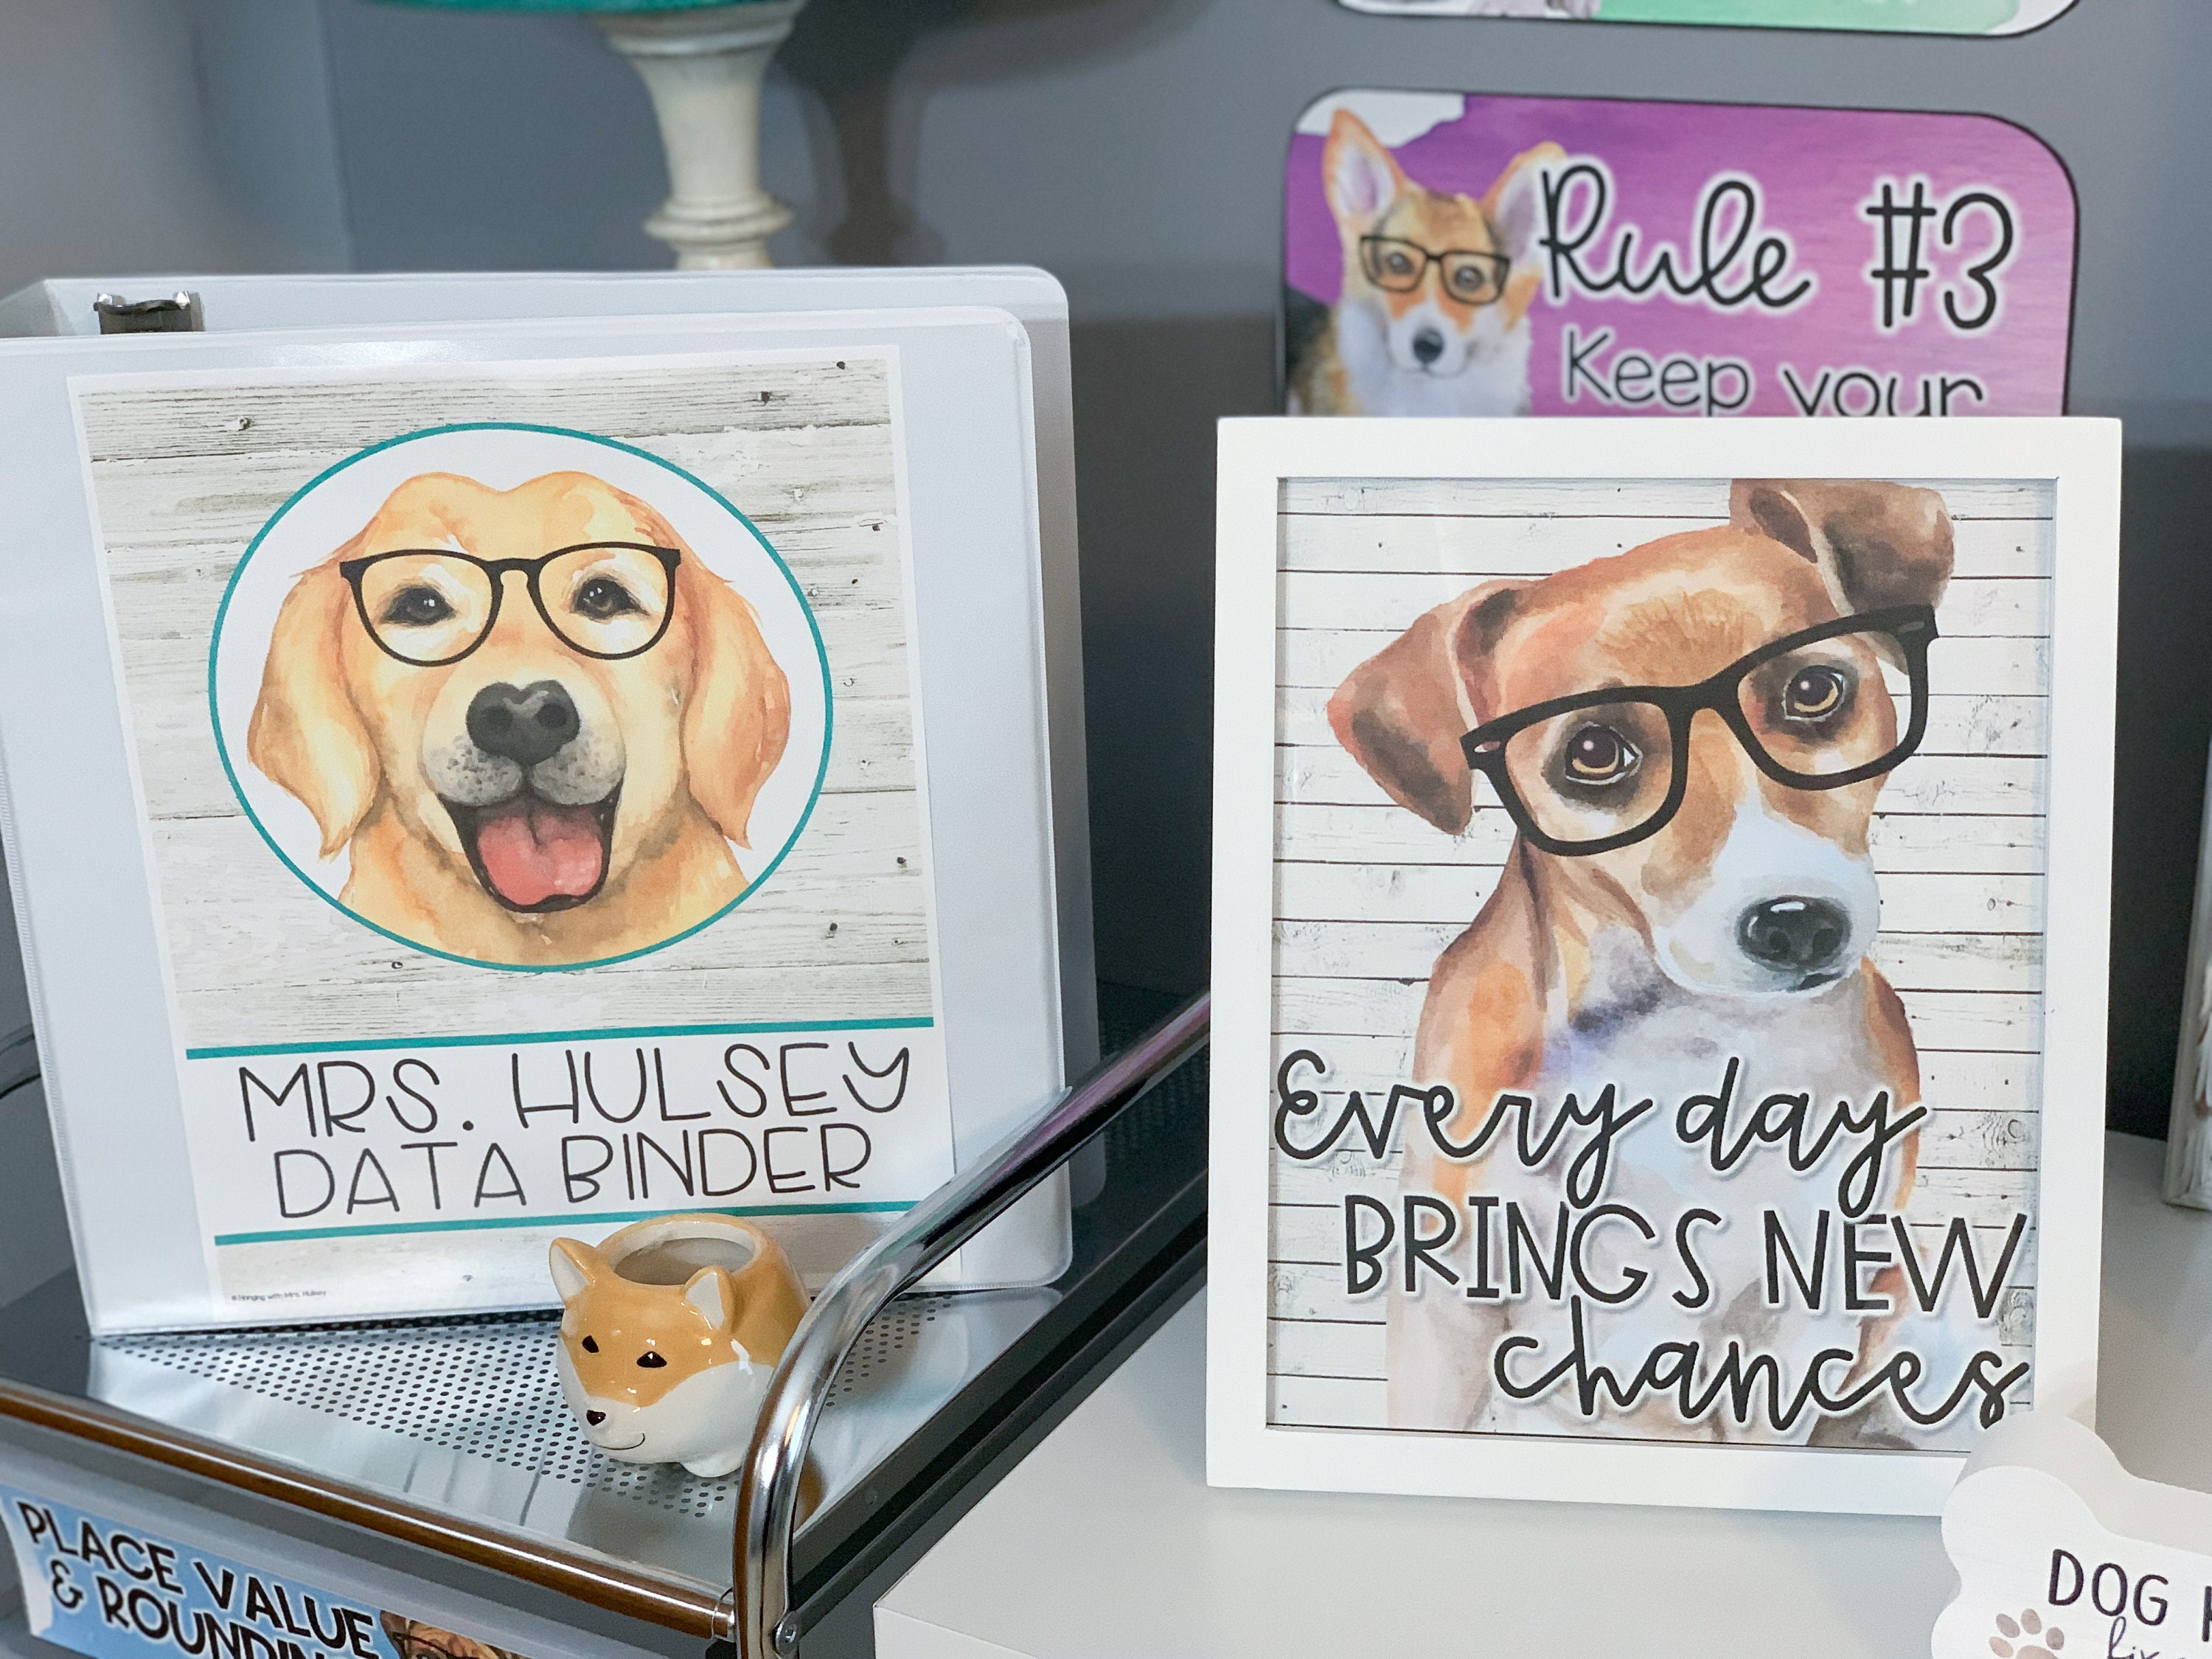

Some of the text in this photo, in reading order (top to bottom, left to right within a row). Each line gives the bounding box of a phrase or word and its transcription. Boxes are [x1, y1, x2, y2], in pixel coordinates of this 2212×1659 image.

[1539, 165, 2014, 329] Rule #3
[1568, 330, 1983, 417] Keep your
[240, 1042, 911, 1141] MRS. HULSEY
[1274, 1049, 1927, 1218] Every day
[274, 1123, 872, 1219] DATA BINDER
[1345, 1194, 2028, 1318] BRINGS NEW
[1494, 1295, 2030, 1430] chances
[18, 1502, 380, 1659] PLACE VALUE
[51, 1559, 83, 1608] &
[2048, 1548, 2169, 1626] DOG
